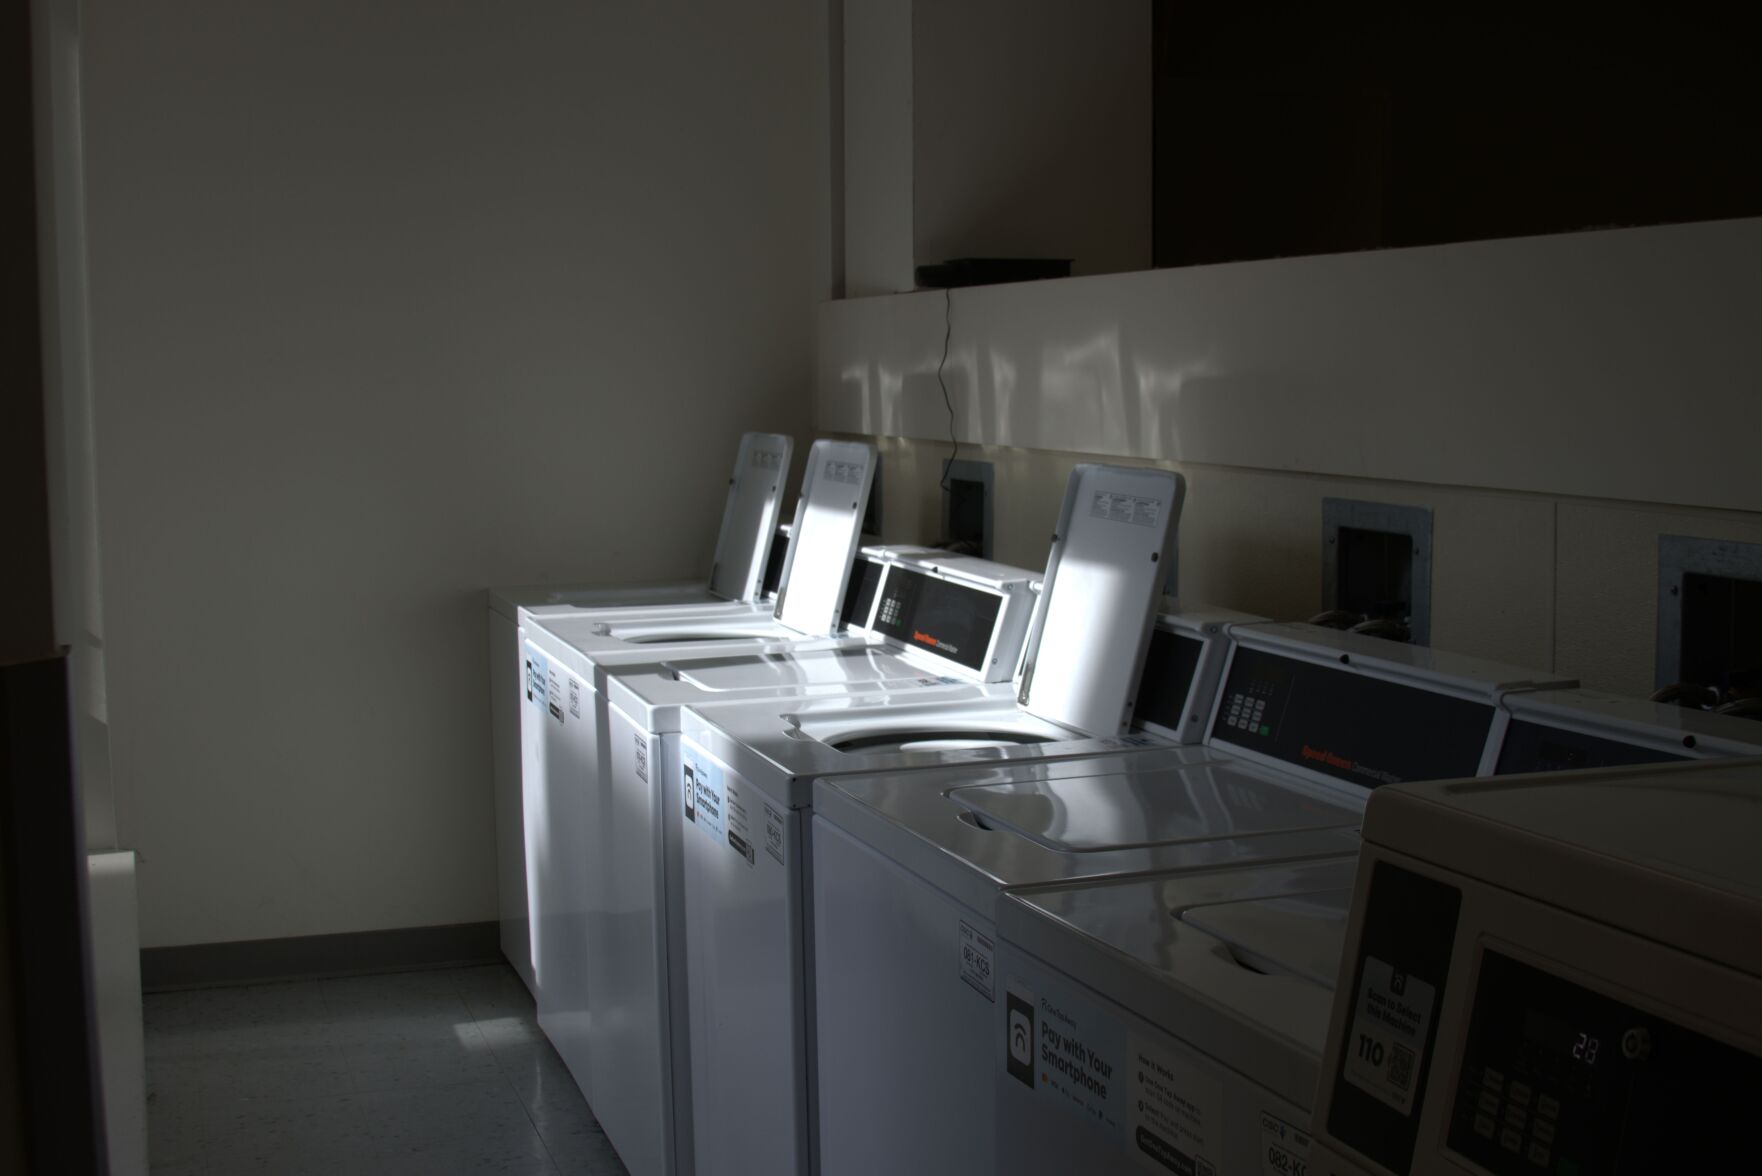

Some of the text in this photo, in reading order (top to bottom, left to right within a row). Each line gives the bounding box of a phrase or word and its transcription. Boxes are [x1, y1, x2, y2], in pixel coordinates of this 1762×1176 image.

[1368, 987, 1422, 1025] Scan to Select
[1042, 1021, 1112, 1080] Pay with Your
[1359, 1033, 1384, 1066] 110
[1572, 1032, 1599, 1064] 28
[1042, 1043, 1107, 1099] Smartphone
